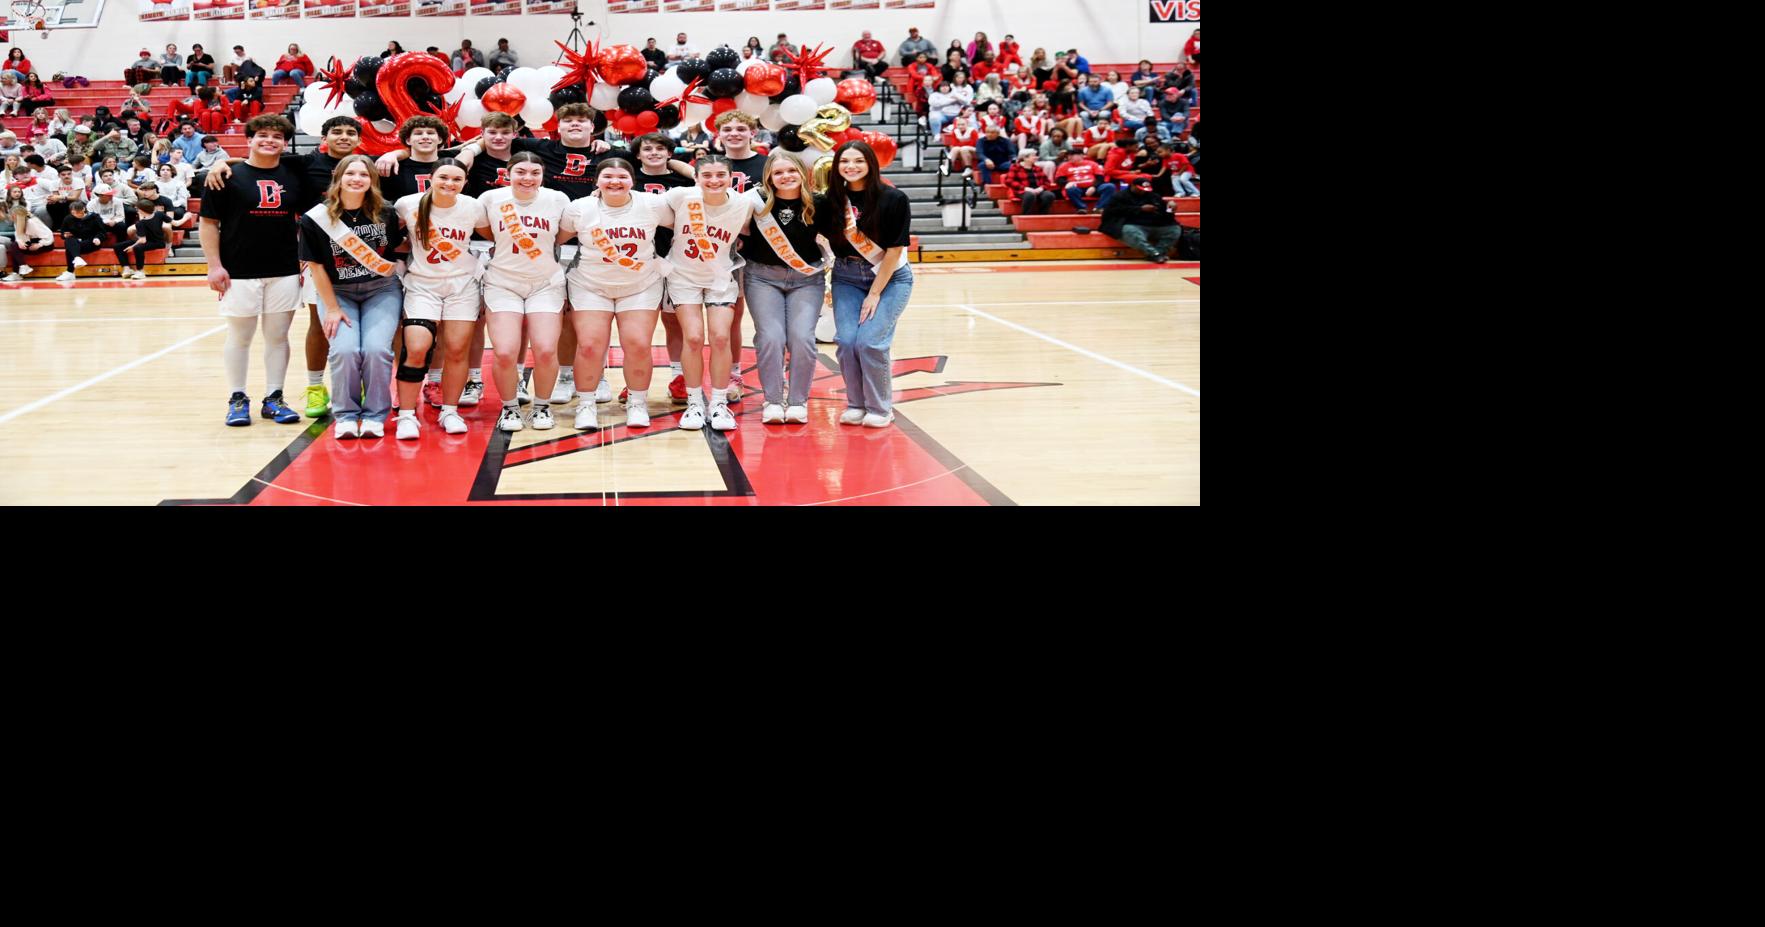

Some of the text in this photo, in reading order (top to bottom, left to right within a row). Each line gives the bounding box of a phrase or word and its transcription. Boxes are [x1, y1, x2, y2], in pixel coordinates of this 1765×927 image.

[605, 226, 647, 241] NCAN
[682, 224, 732, 244] DCAN
[684, 238, 719, 262] 3
